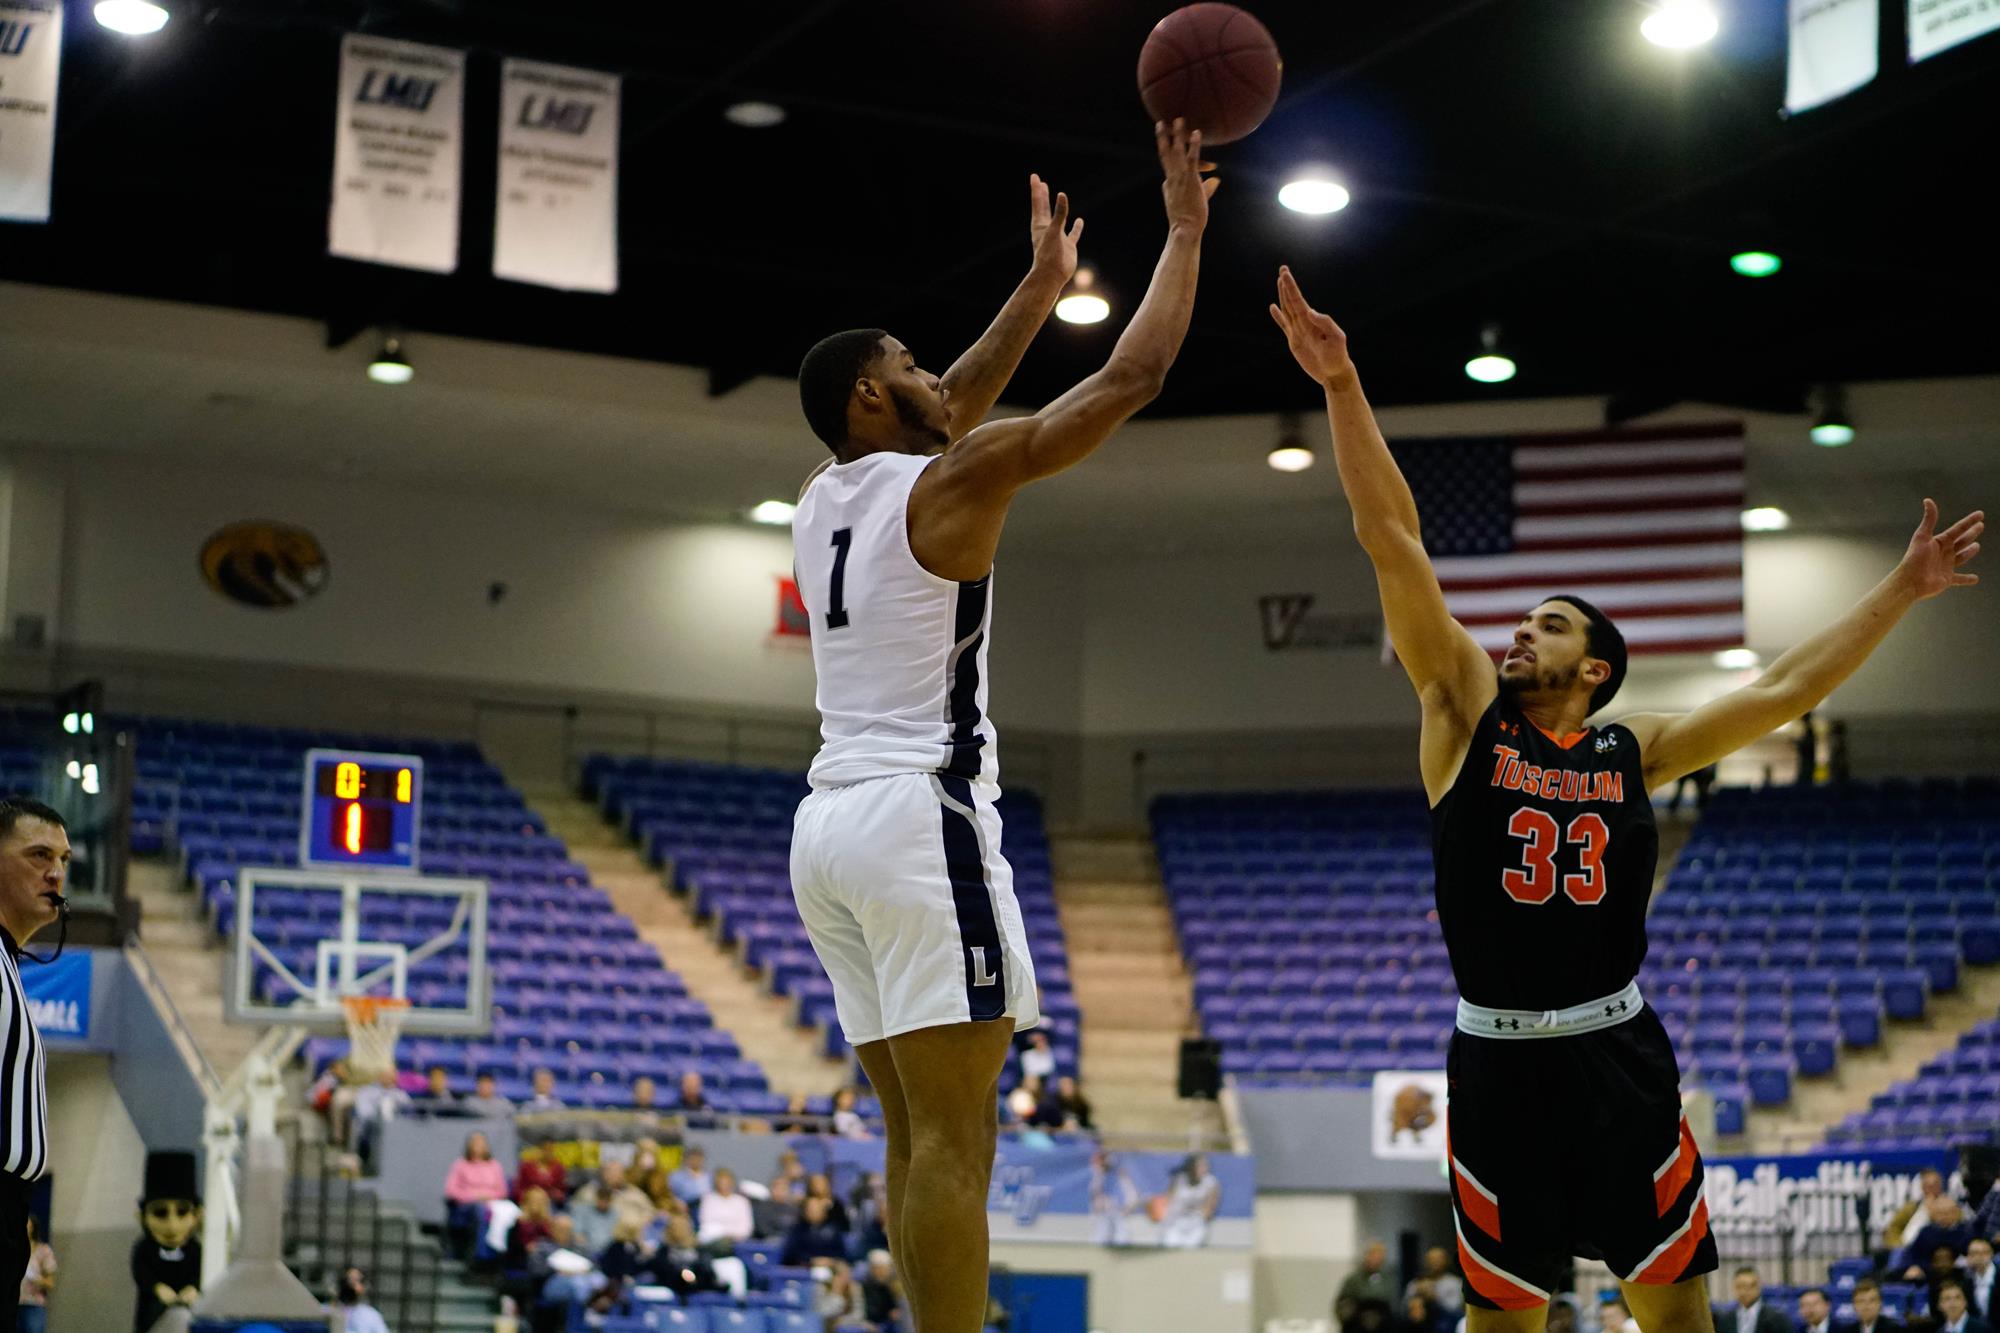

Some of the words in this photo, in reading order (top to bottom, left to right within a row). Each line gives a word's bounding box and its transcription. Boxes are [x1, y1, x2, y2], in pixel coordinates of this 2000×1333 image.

[354, 67, 440, 114] LMU
[825, 525, 852, 631] 1
[345, 801, 362, 854] 1
[1502, 806, 1609, 905] 33
[970, 946, 996, 987] L
